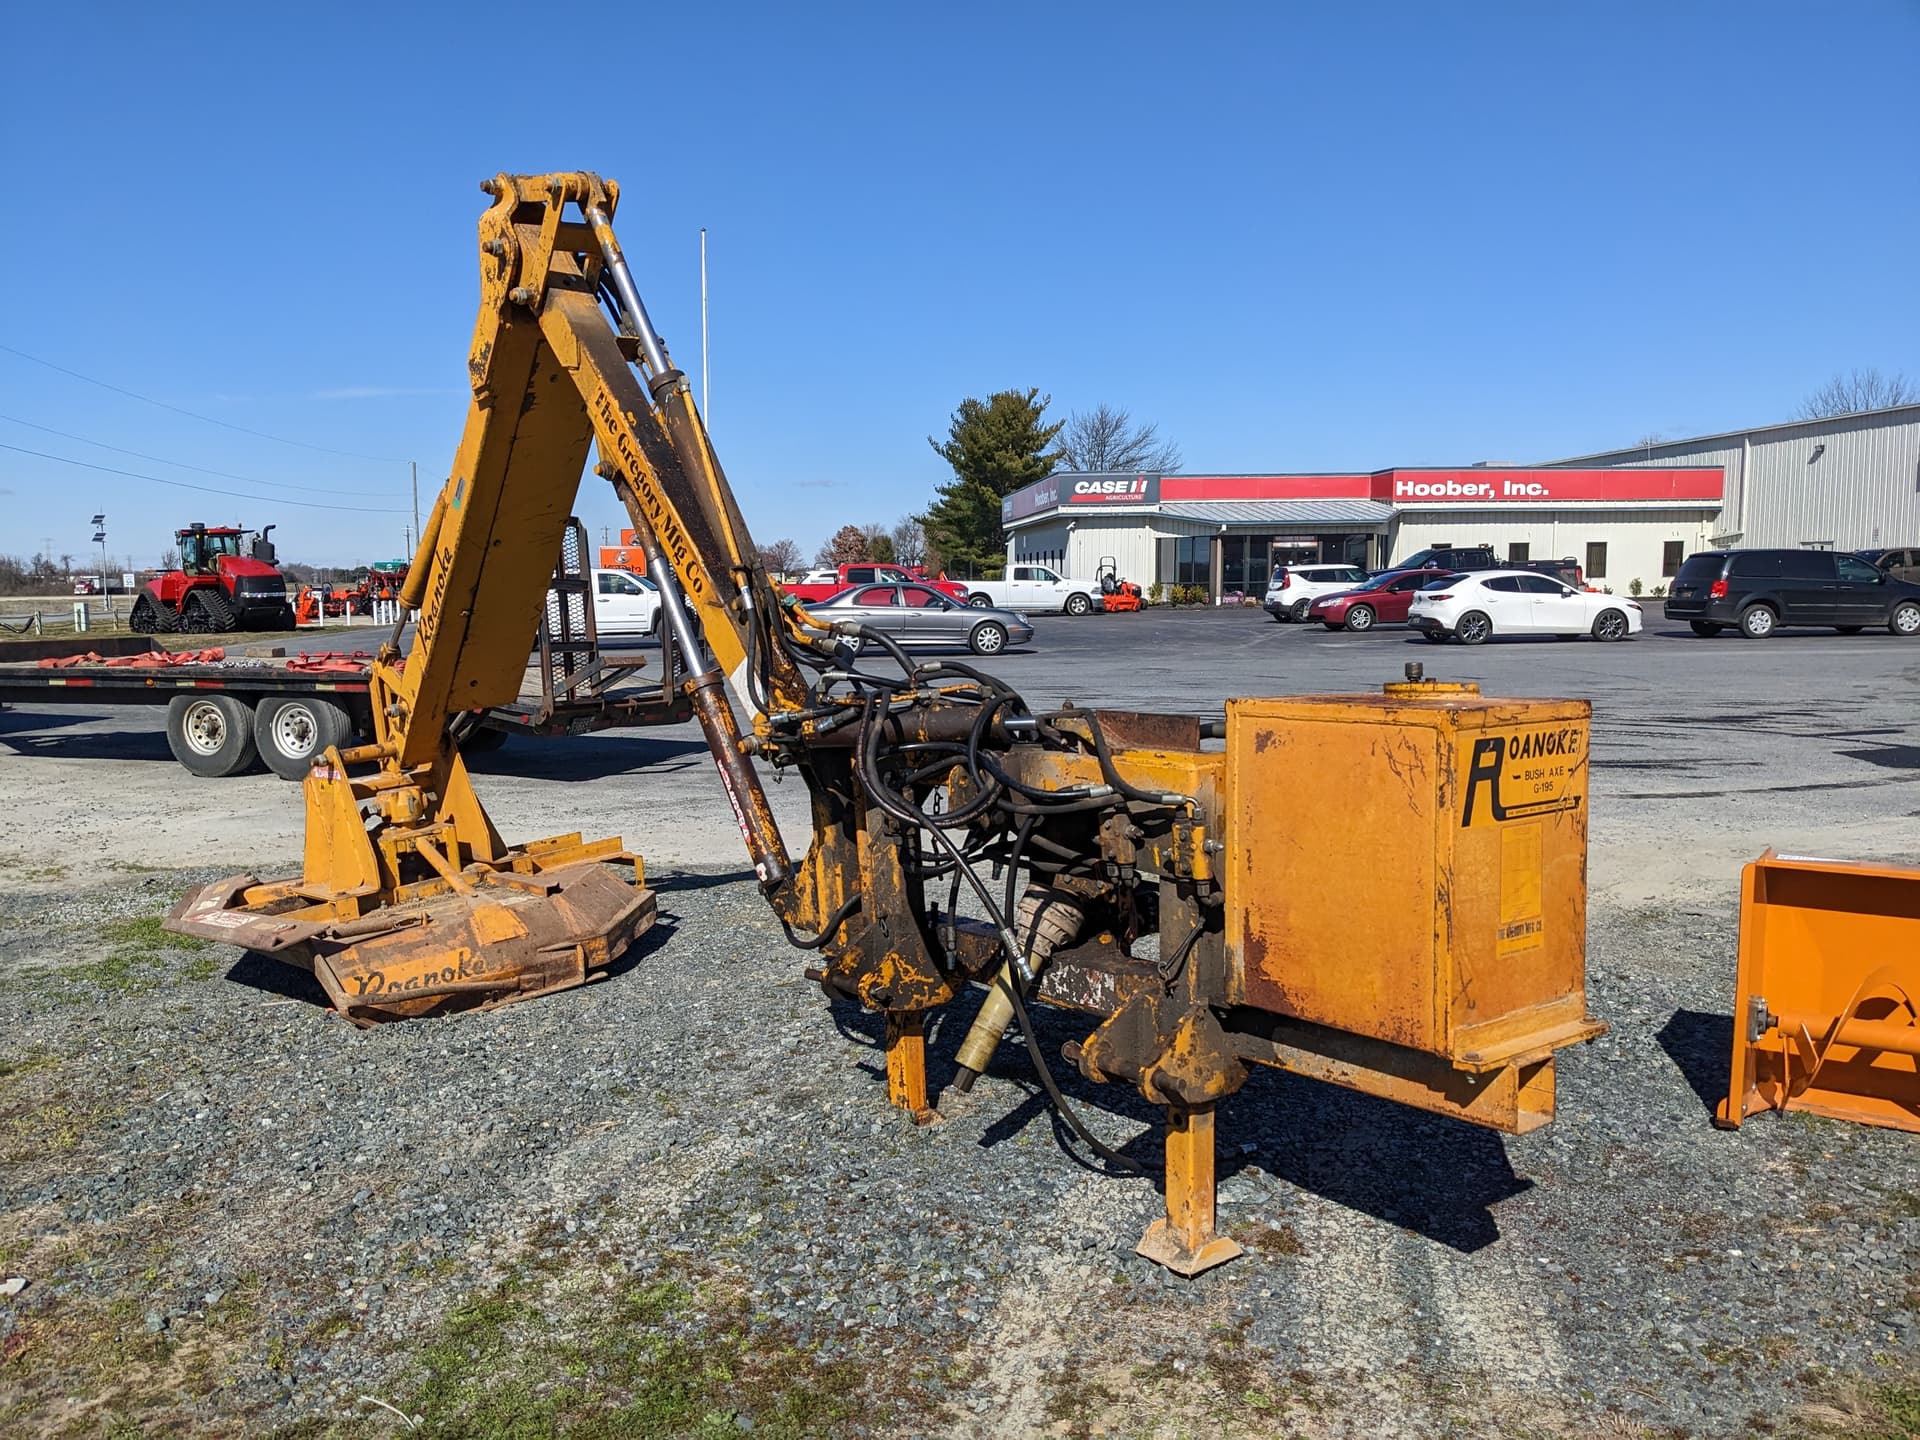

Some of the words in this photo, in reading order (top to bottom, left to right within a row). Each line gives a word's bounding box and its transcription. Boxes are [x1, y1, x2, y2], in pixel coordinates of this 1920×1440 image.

[594, 386, 618, 435] The
[617, 432, 664, 519] Gregory
[663, 517, 687, 567] Mfg.
[686, 561, 702, 598] Co.
[1074, 480, 1128, 494] CASE
[1395, 480, 1496, 499] Hoober,
[1503, 480, 1549, 496] Inc.
[1105, 493, 1143, 501] AGRICULTURE
[417, 546, 453, 656] Roanoke
[1524, 769, 1545, 781] BUSH
[1548, 765, 1565, 777] AXE
[1533, 781, 1554, 794] G-195
[353, 950, 486, 996] Roanoke
